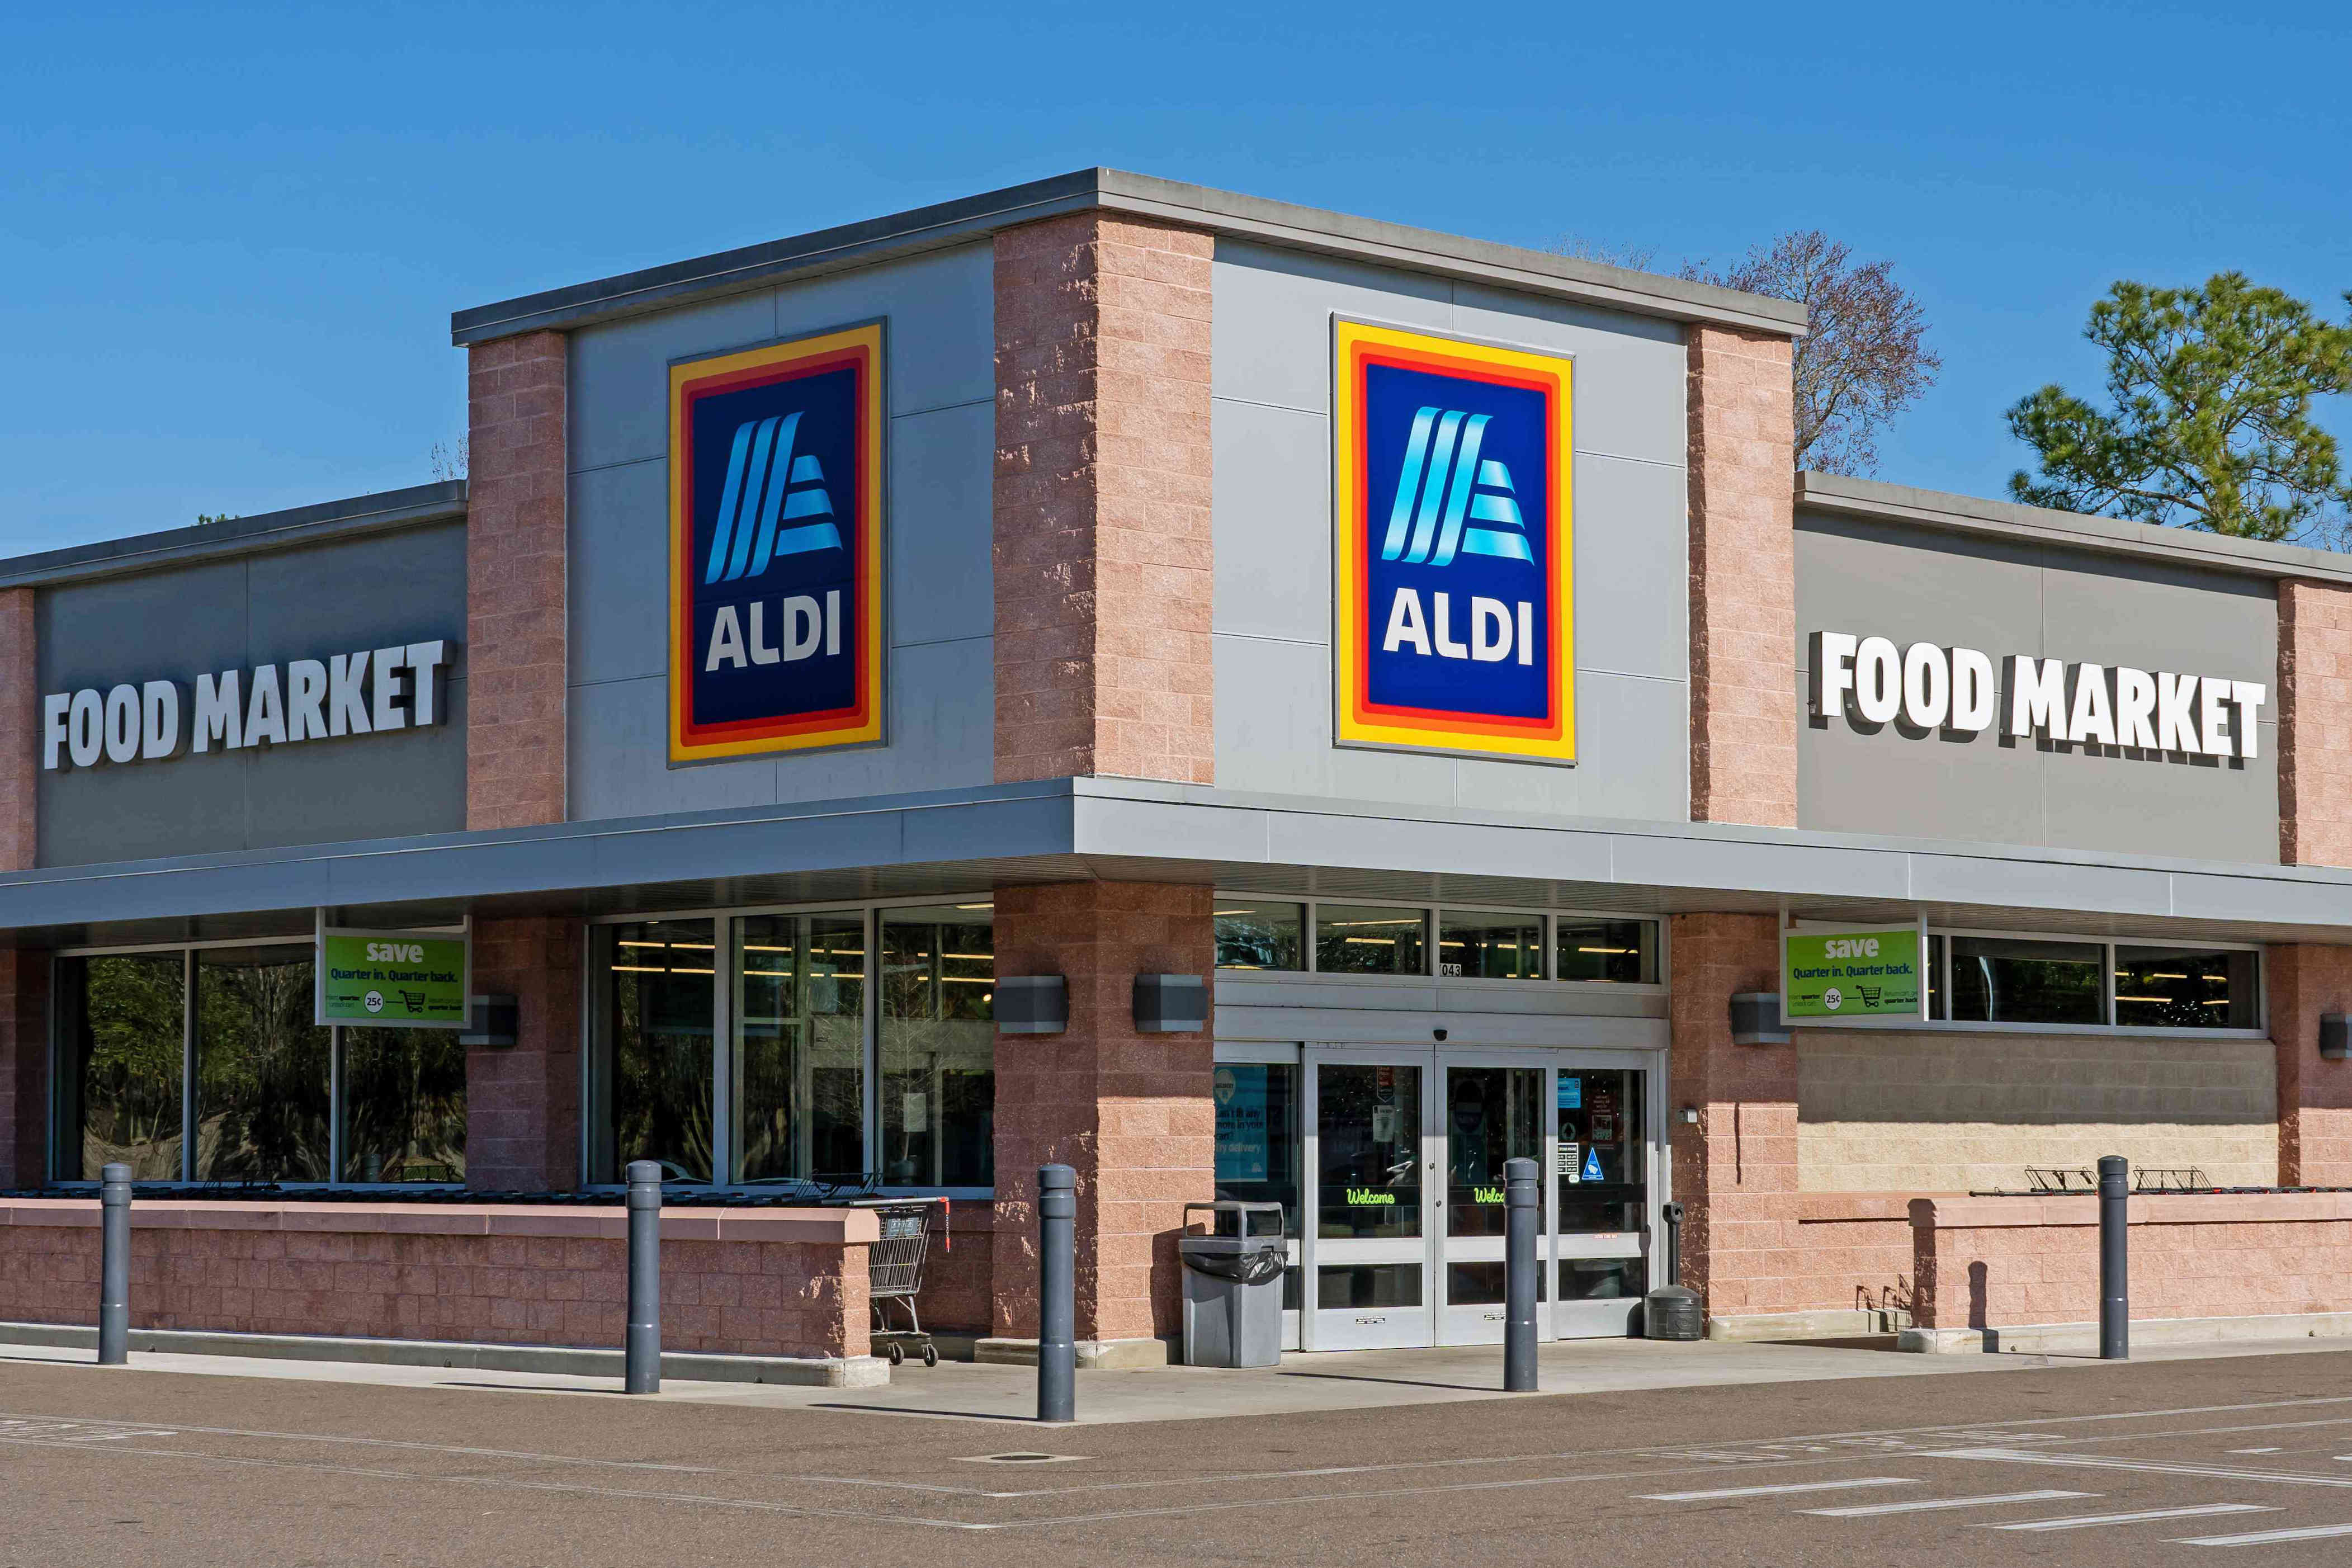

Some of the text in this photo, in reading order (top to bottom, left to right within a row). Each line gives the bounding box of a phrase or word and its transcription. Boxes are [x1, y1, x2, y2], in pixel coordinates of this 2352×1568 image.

[705, 589, 840, 672] ALDI
[1382, 587, 1533, 666] ALDI
[1817, 630, 2267, 759] FOOD MARKET
[44, 639, 445, 770] FOOD MARKET
[366, 942, 424, 963] save
[1825, 938, 1879, 959] save
[330, 968, 458, 983] Quarter in. Quarter back.
[1439, 964, 1461, 976] 043
[1793, 962, 1913, 980] Quarter in. Quarter back.
[366, 996, 382, 1006] 25¢
[1826, 994, 1841, 1004] 25¢
[1347, 1187, 1395, 1205] Welcome
[1473, 1187, 1504, 1203] Welco
